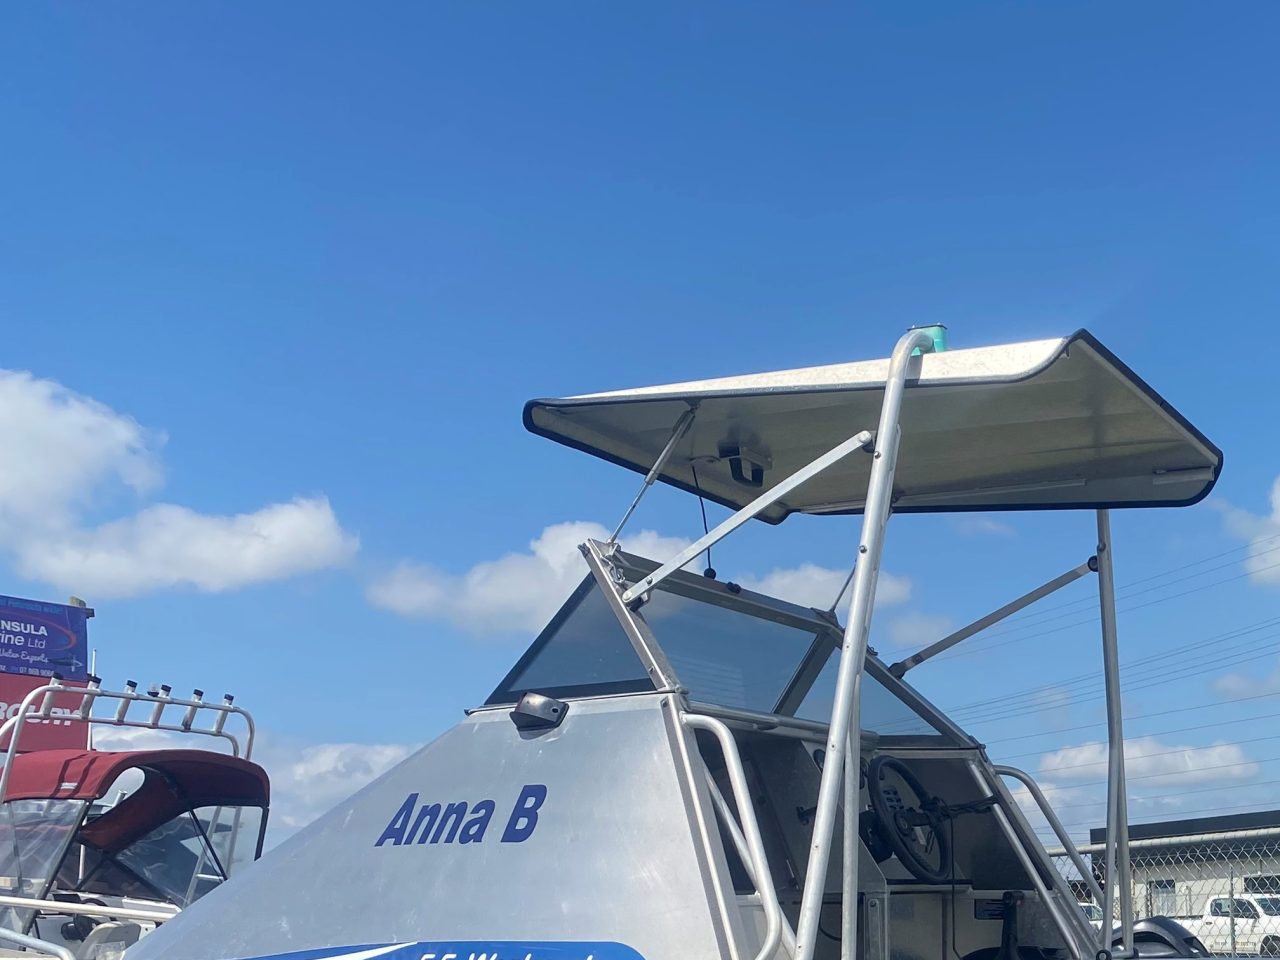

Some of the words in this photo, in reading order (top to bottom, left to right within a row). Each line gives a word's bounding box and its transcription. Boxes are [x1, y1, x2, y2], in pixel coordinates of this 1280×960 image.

[27, 637, 46, 649] Ltd
[374, 793, 496, 847] Anna
[500, 784, 547, 843] B
